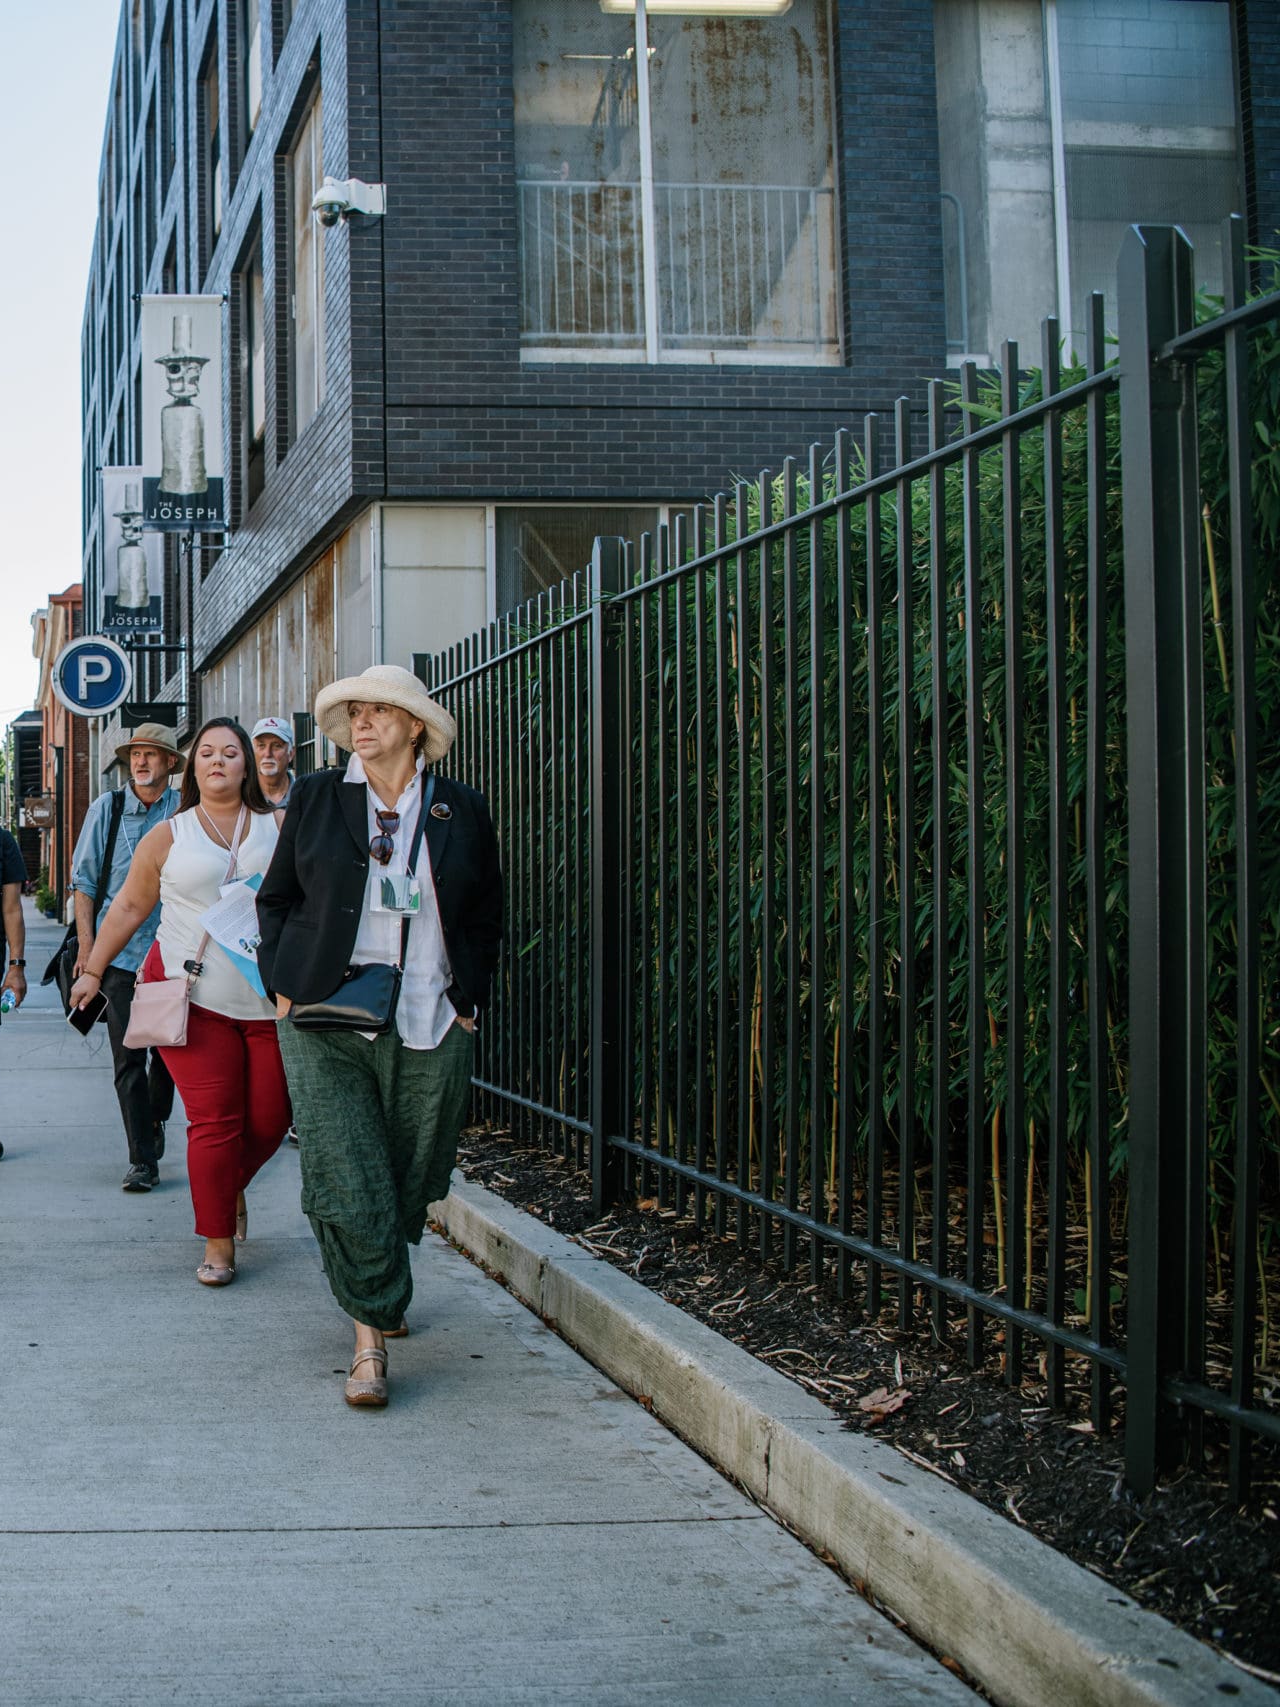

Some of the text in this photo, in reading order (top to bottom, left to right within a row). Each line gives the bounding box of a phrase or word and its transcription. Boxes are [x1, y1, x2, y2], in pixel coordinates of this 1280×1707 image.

[150, 507, 217, 519] JOSEPH
[109, 616, 157, 626] JOSEPH
[78, 654, 112, 700] P
